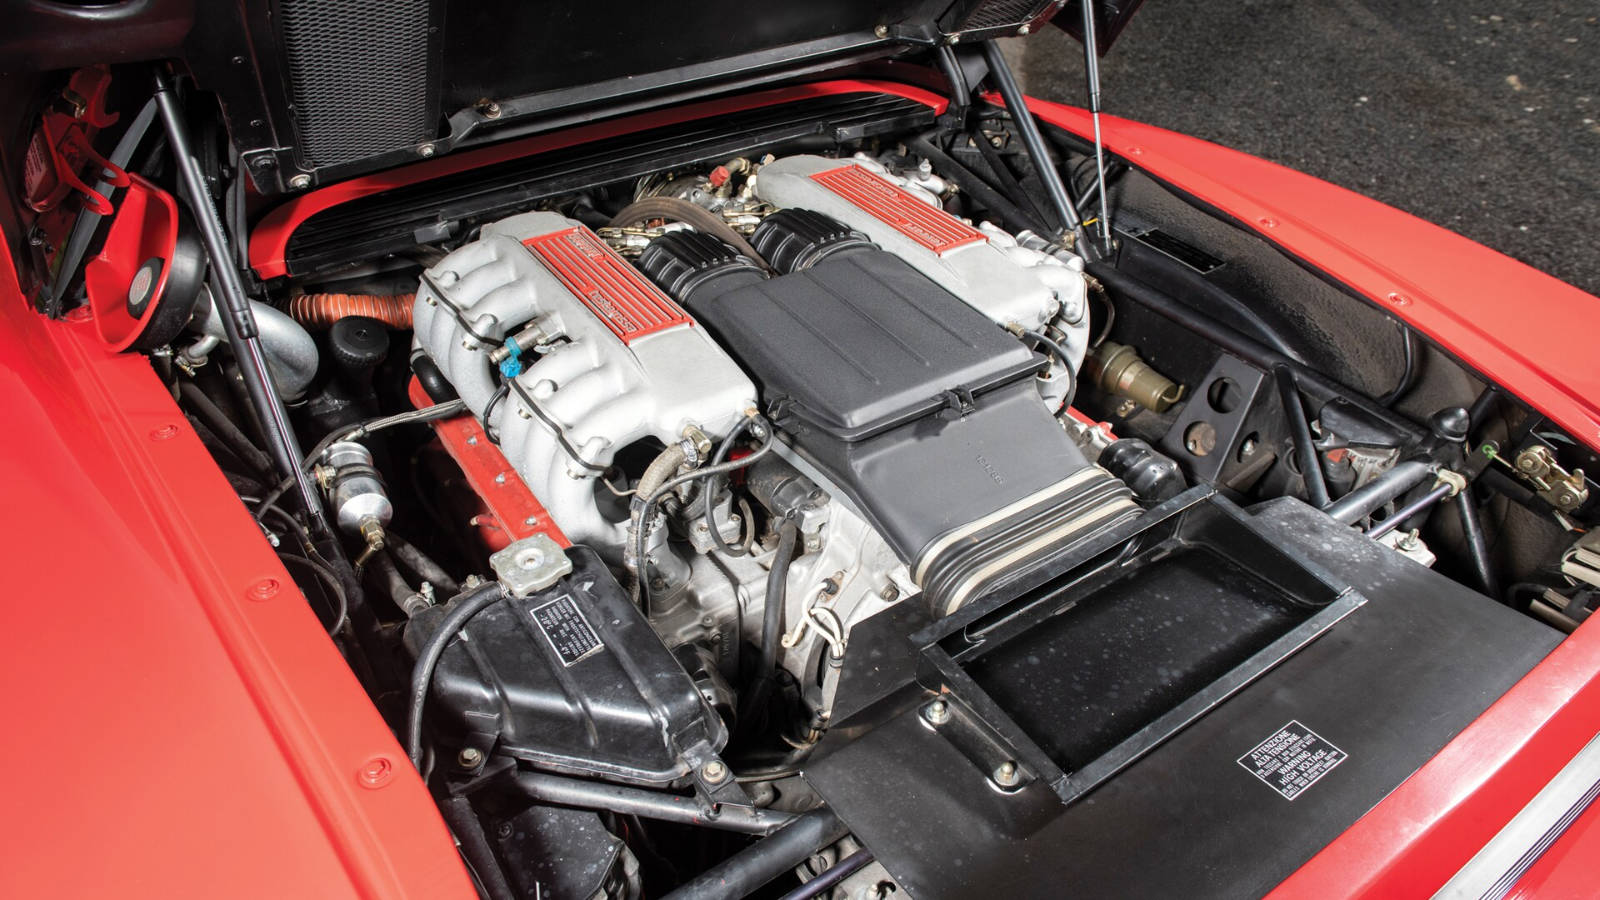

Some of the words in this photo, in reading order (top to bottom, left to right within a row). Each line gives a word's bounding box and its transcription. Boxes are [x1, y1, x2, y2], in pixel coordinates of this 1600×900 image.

[1250, 730, 1291, 760] ATTENZIONE
[1253, 753, 1273, 767] ALTA
[1267, 732, 1300, 756] TENSIONE
[1277, 749, 1312, 775] WARNING
[1278, 769, 1300, 785] HIGH
[1296, 748, 1327, 772] VOLTAGE
